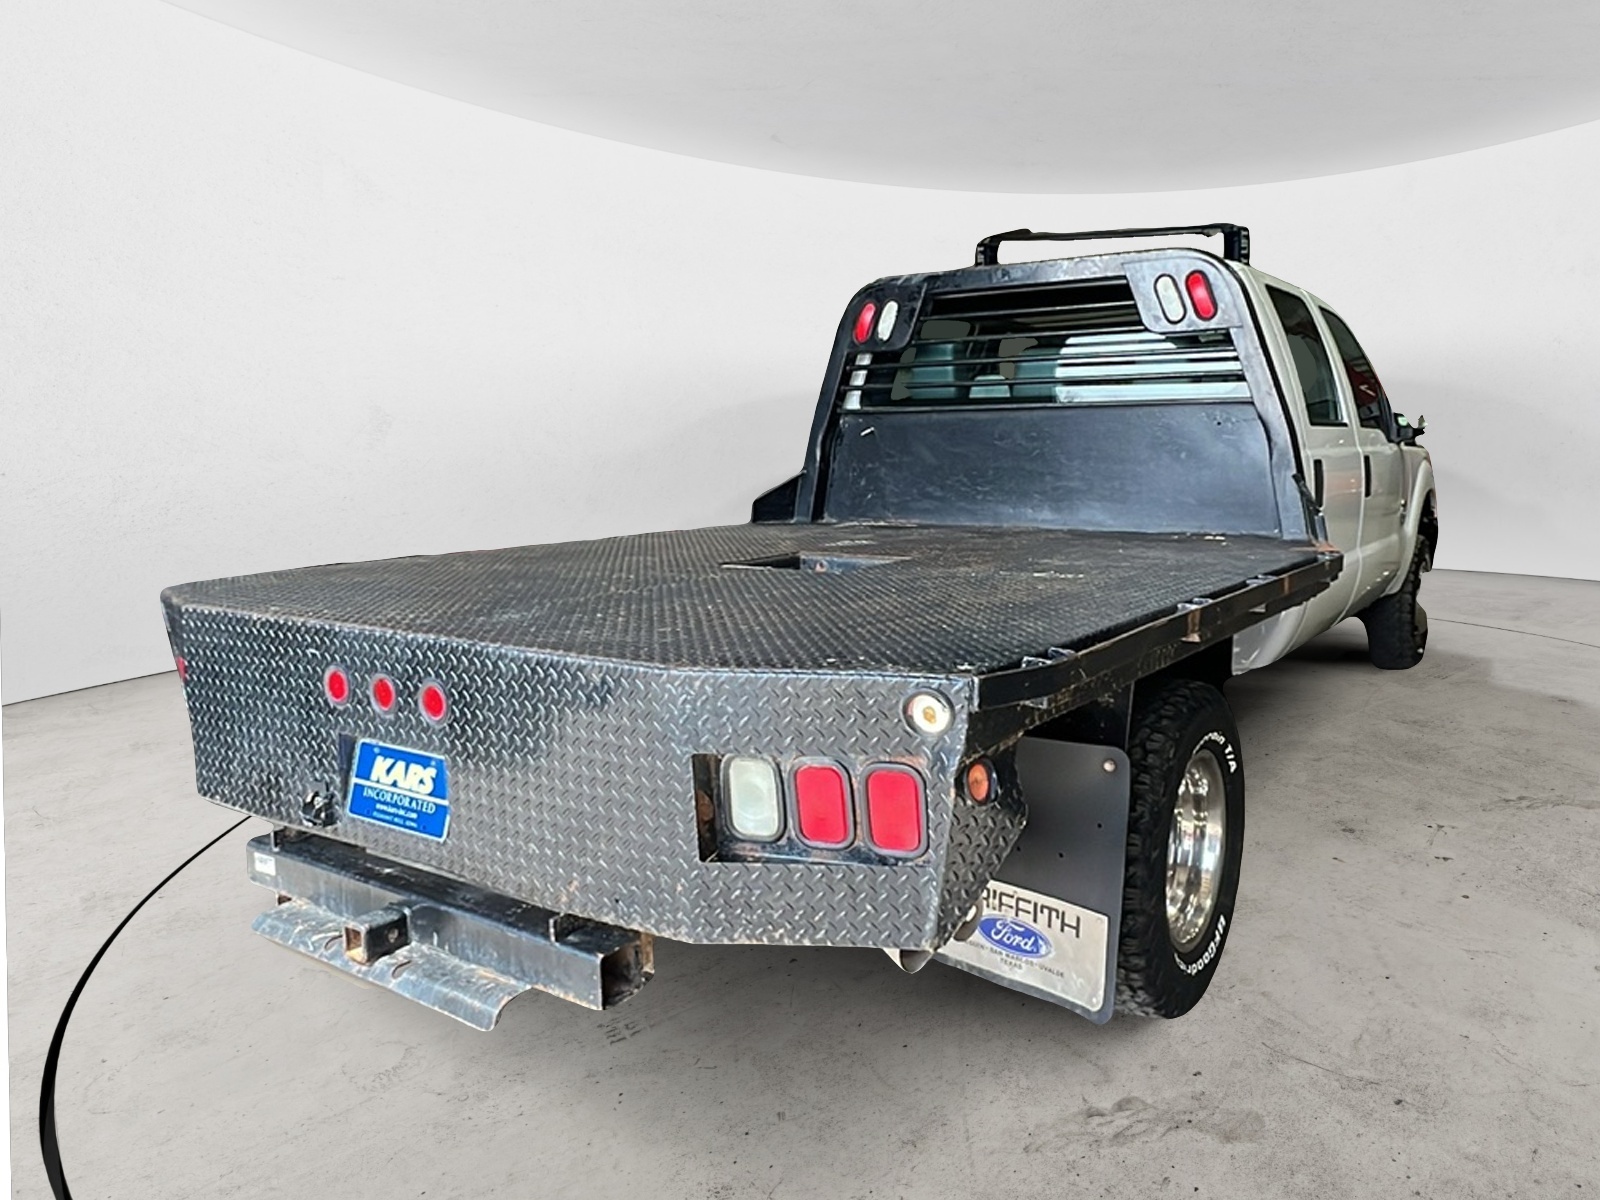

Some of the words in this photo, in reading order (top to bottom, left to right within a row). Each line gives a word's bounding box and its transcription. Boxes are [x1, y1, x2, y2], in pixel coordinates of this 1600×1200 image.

[1224, 743, 1238, 774] T/A
[369, 755, 438, 795] KARS
[362, 786, 437, 814] INCORPORATED
[991, 918, 1037, 952] Ford
[1173, 914, 1227, 976] BFGoodr
[999, 957, 1023, 970] TEXAS
[1039, 963, 1065, 978] UVALDE
